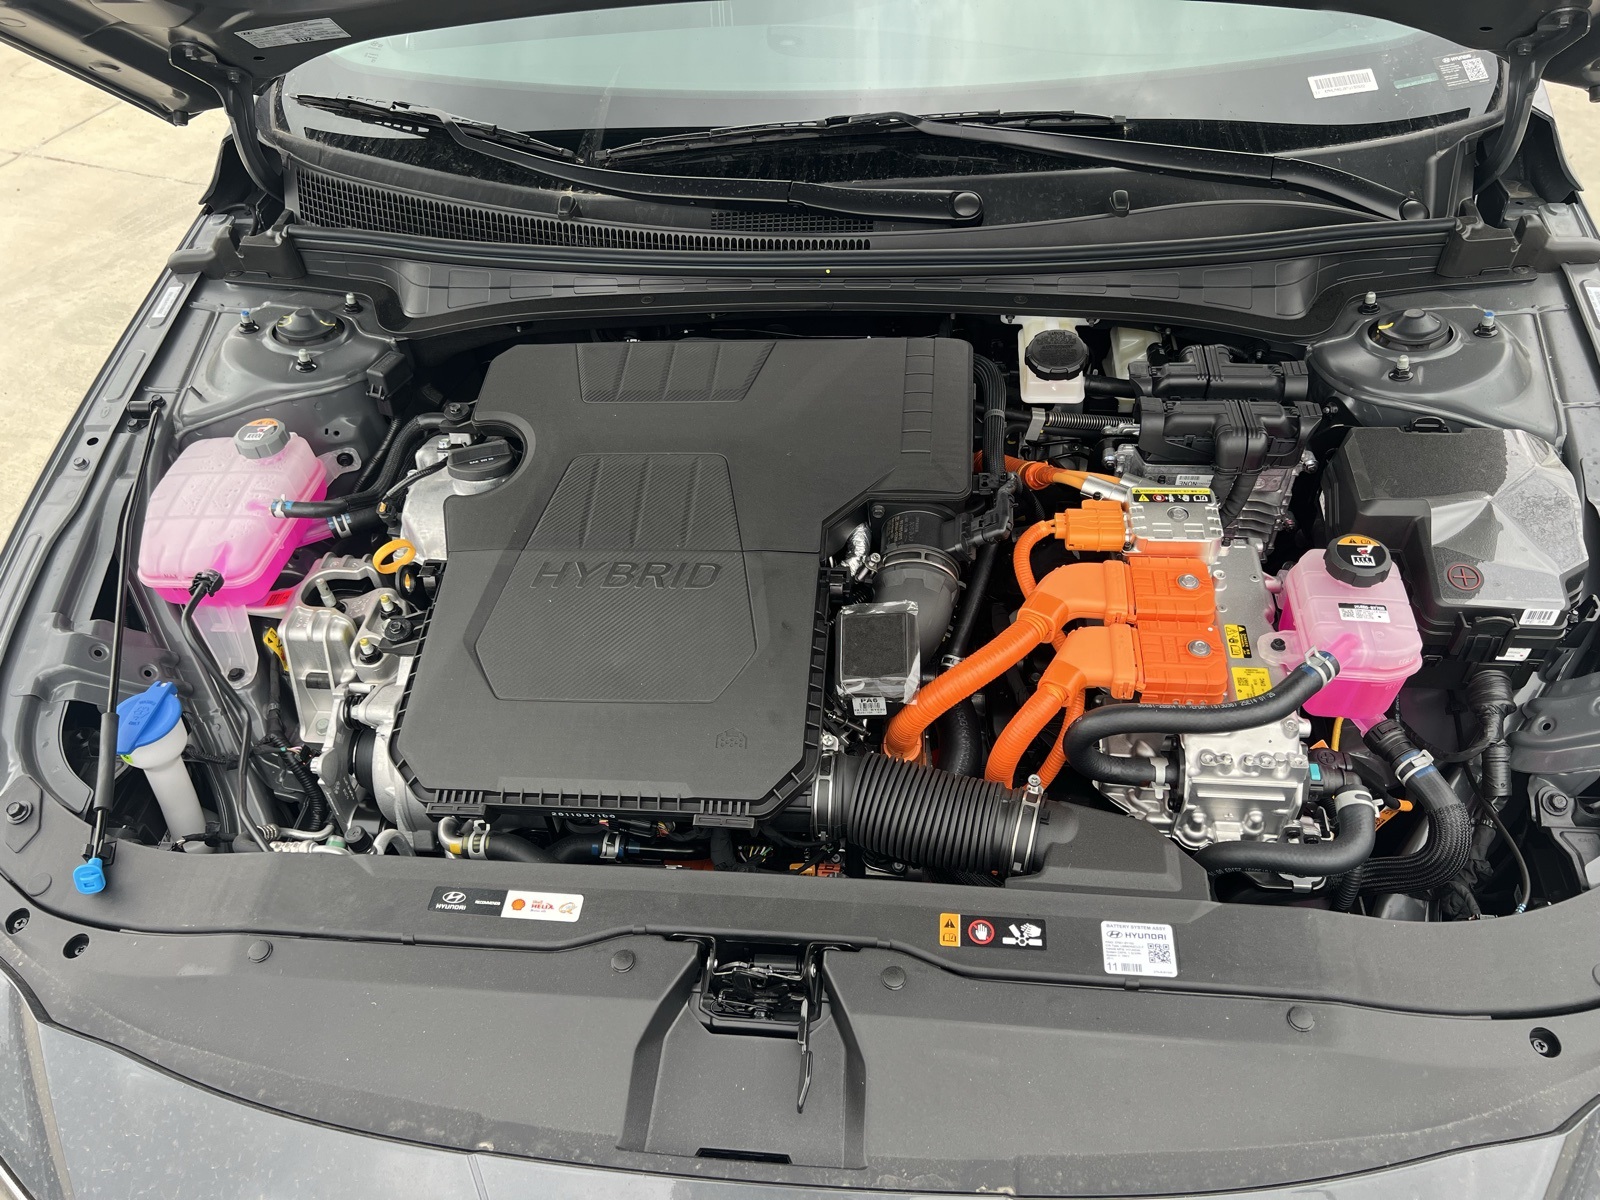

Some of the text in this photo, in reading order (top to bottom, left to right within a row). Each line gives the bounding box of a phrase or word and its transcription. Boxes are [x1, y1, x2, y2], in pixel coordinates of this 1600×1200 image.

[529, 561, 723, 590] HYBRID
[1125, 932, 1167, 940] HYUNDAI
[1107, 962, 1117, 971] 11
